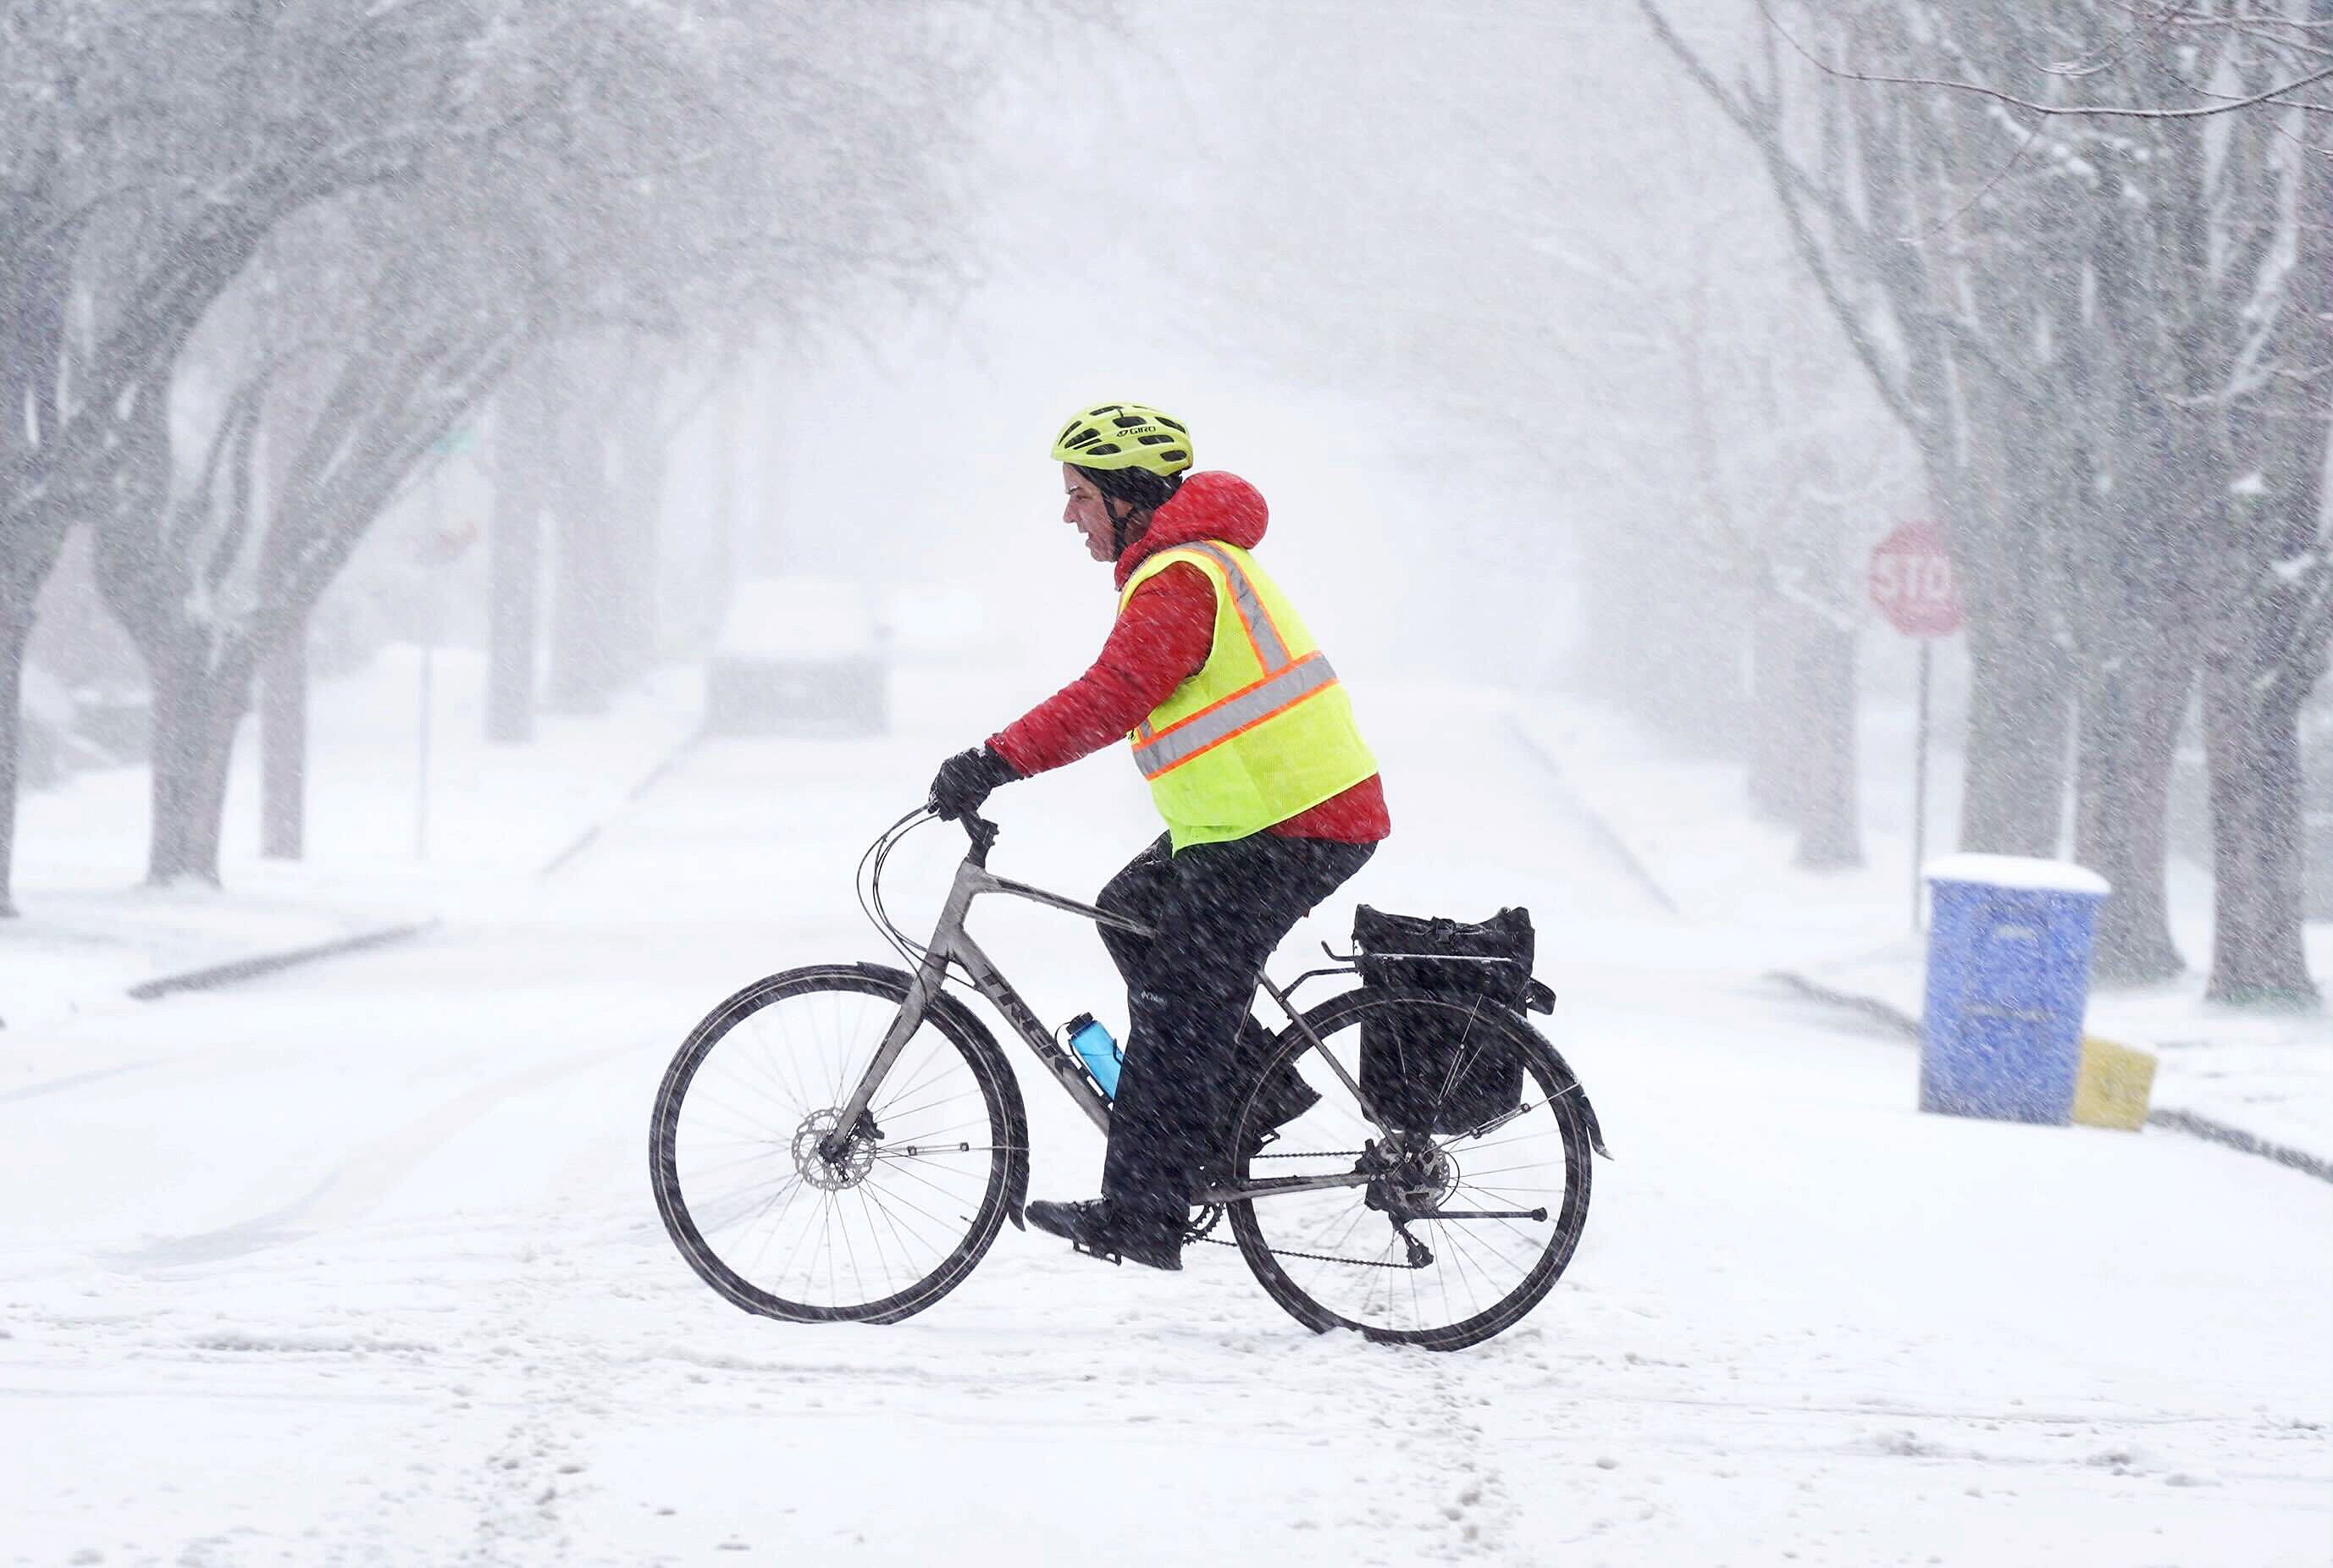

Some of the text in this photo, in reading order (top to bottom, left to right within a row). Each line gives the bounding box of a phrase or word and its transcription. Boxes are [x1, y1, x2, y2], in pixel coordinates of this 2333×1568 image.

[1130, 426, 1156, 434] GIRO
[1871, 555, 1953, 598] STO
[981, 963, 1077, 1077] TREK
